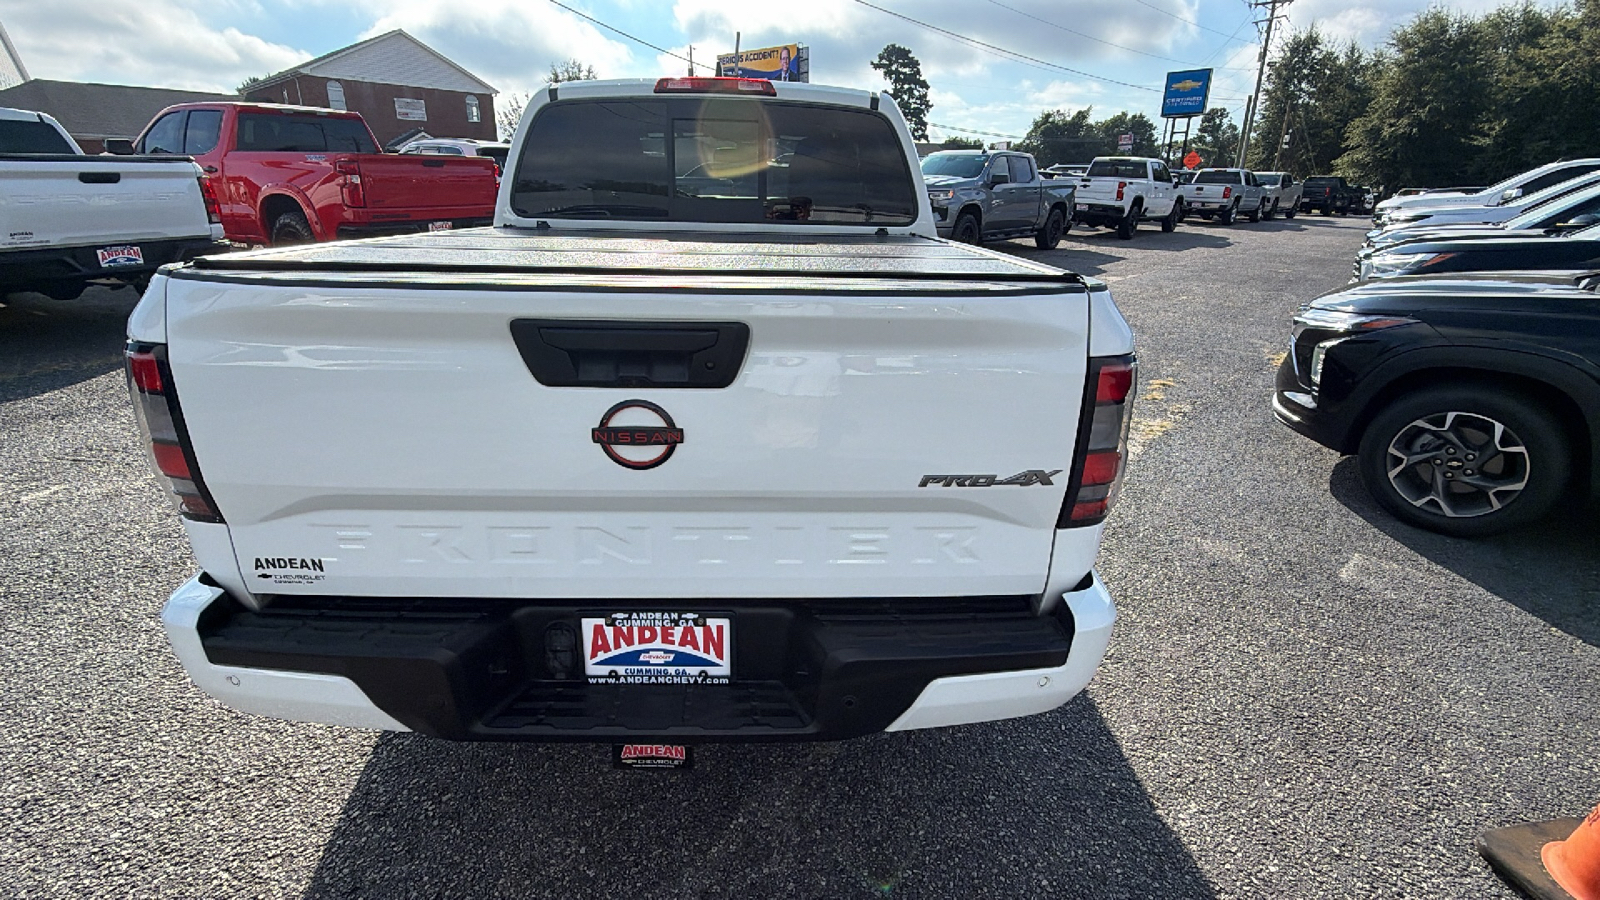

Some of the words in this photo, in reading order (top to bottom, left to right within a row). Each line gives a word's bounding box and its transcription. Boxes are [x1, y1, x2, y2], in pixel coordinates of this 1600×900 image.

[745, 50, 778, 61] ACCIDENT?
[101, 247, 141, 261] ANDEAN
[594, 431, 681, 443] NISSAN
[917, 469, 1063, 488] PRO-4X
[307, 525, 981, 565] FRONTIER
[254, 558, 324, 572] ANDEAN
[631, 612, 679, 620] ANDEAN
[679, 619, 695, 627] GA
[589, 624, 724, 660] ANDEAN
[624, 668, 672, 676] CUMMING,
[674, 668, 691, 676] GA.
[588, 676, 730, 685] www.ANDEANCHEVY.com
[621, 745, 685, 759] ANDEAN
